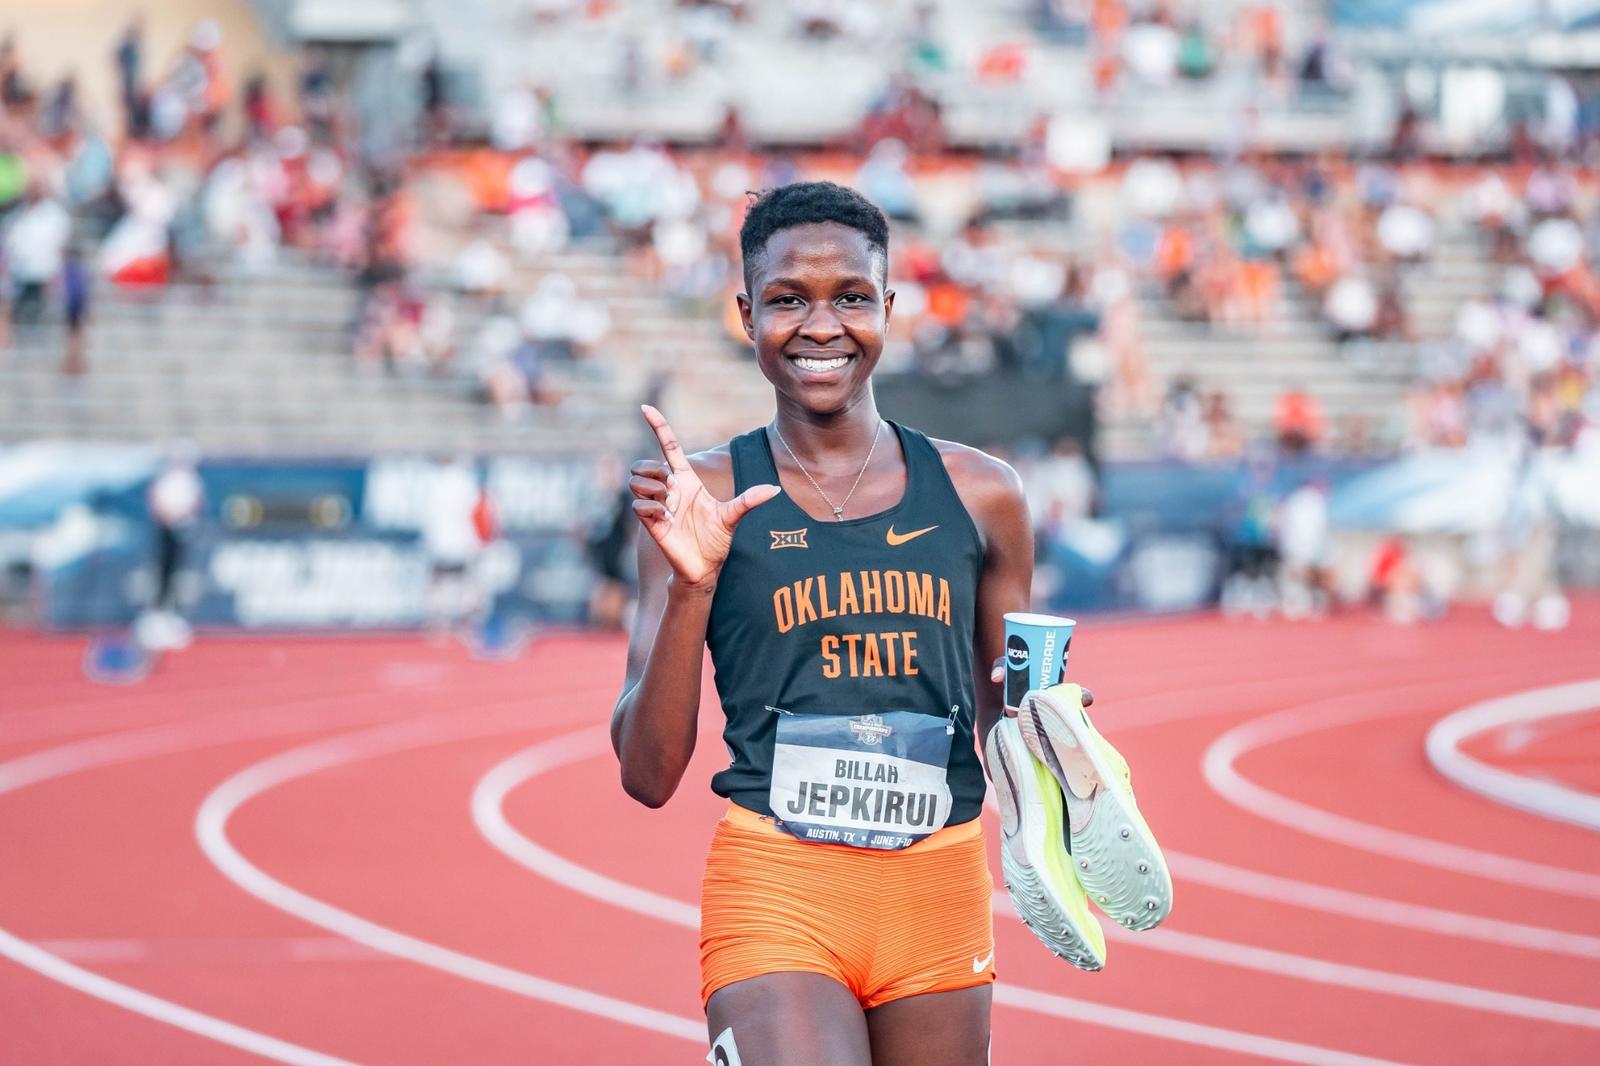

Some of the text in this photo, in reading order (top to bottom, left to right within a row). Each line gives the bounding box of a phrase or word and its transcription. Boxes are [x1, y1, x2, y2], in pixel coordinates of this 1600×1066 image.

[773, 570, 951, 634] OKLAHOMA
[820, 631, 919, 679] STATE
[1008, 648, 1029, 659] NCAA
[1040, 631, 1056, 690] WERADE
[834, 759, 899, 784] BILLAH
[786, 781, 937, 827] JEPKIRUI
[806, 828, 913, 847] AUSTIN, TX JUNE 7-10
